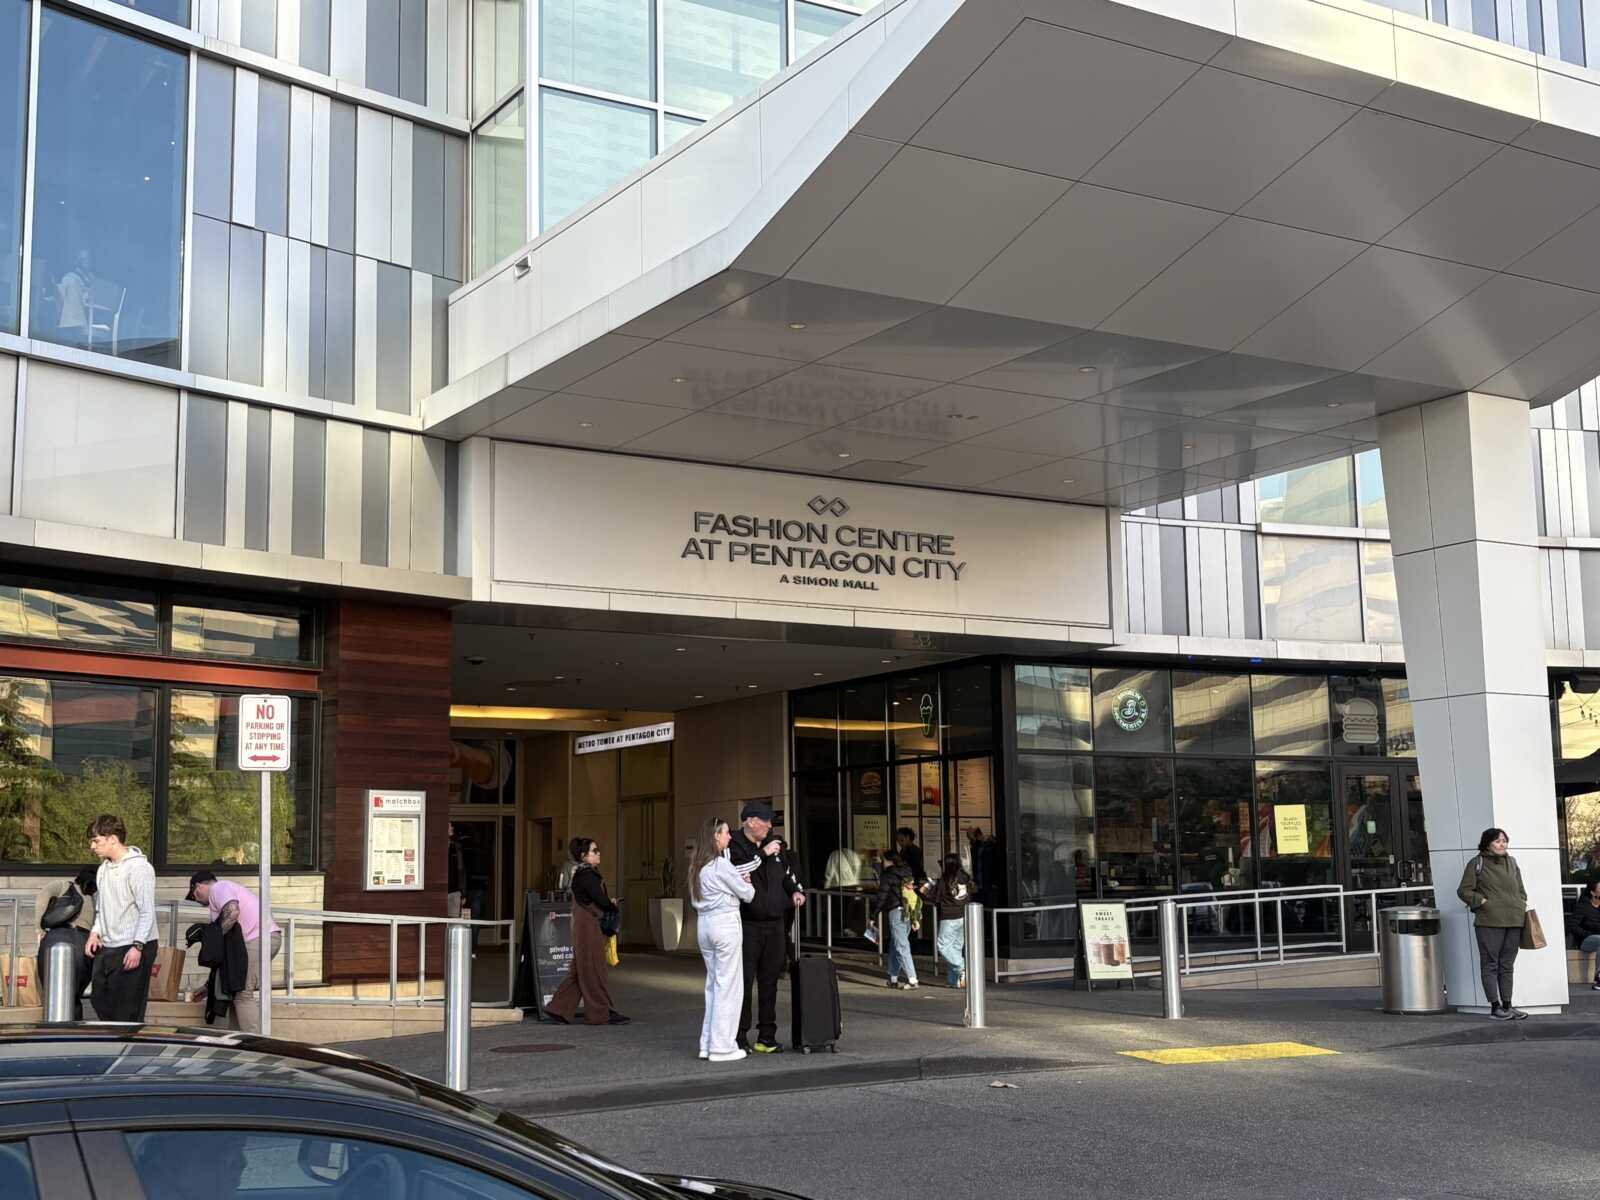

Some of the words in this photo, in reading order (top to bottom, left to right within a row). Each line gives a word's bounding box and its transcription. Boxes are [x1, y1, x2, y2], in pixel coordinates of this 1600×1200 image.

[694, 511, 828, 544] FASHION
[835, 525, 956, 556] CENTRE
[680, 537, 722, 561] AT
[729, 541, 896, 576] PENTAGON
[902, 556, 967, 581] CITY
[779, 574, 790, 584] A
[793, 575, 839, 588] SIMON
[842, 579, 879, 591] MALL
[256, 704, 275, 720] NO
[245, 722, 274, 731] PARKING
[275, 722, 285, 731] OR
[249, 732, 281, 740] STOPPING
[578, 740, 595, 749] METRO
[597, 736, 615, 746] TOWER
[616, 734, 623, 743] AT
[624, 731, 655, 742] PENTAGON
[656, 728, 671, 737] CITY
[245, 743, 253, 751] AT
[254, 742, 268, 751] ANY
[269, 743, 285, 751] TIME
